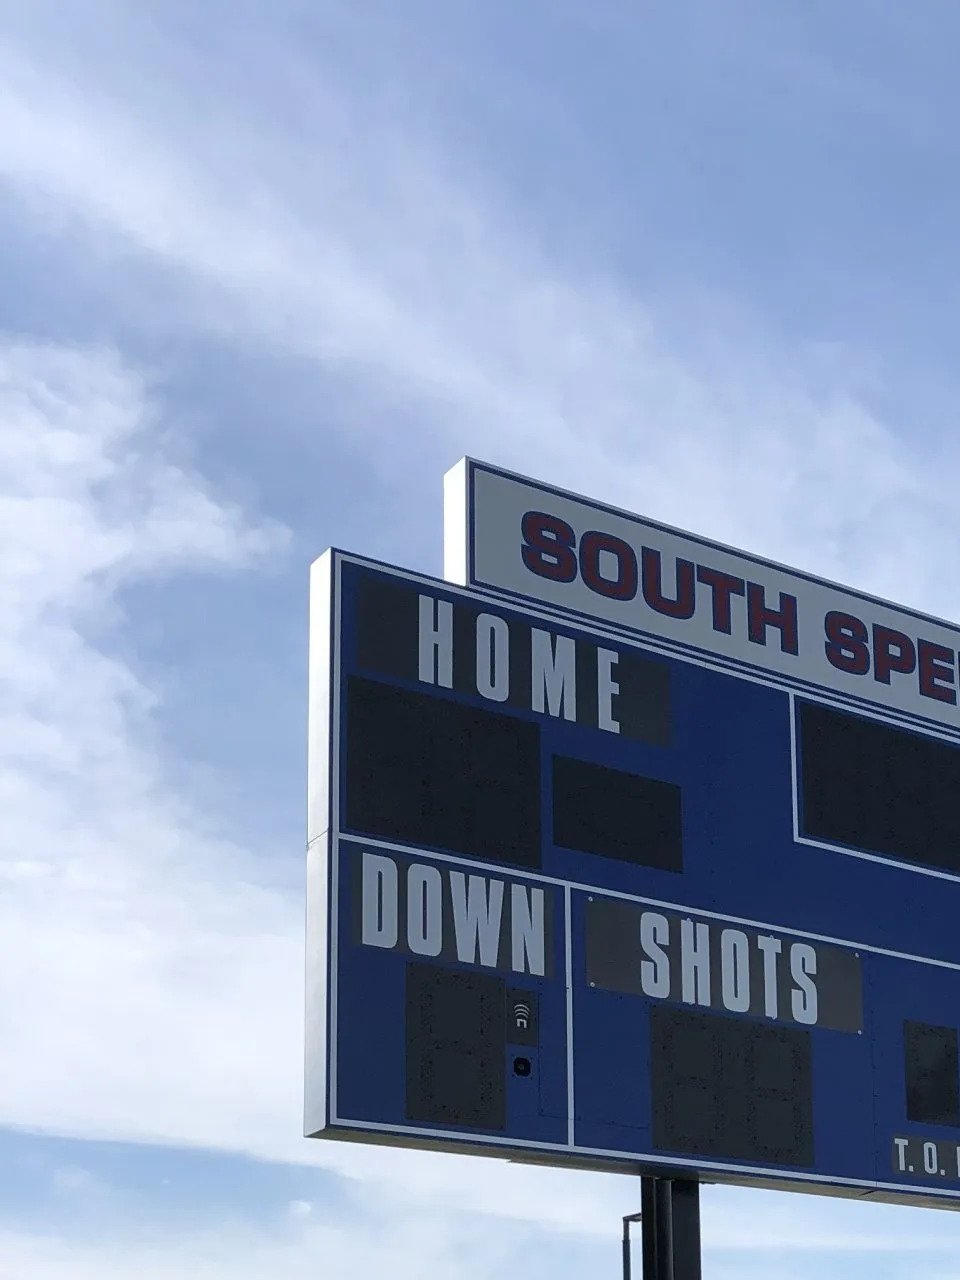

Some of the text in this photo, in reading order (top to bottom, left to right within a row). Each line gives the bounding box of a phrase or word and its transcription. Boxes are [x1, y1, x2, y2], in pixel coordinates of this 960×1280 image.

[520, 510, 799, 657] SOUTH
[418, 594, 621, 734] HOME
[362, 852, 546, 977] DOWN
[640, 911, 818, 1026] SHOTS
